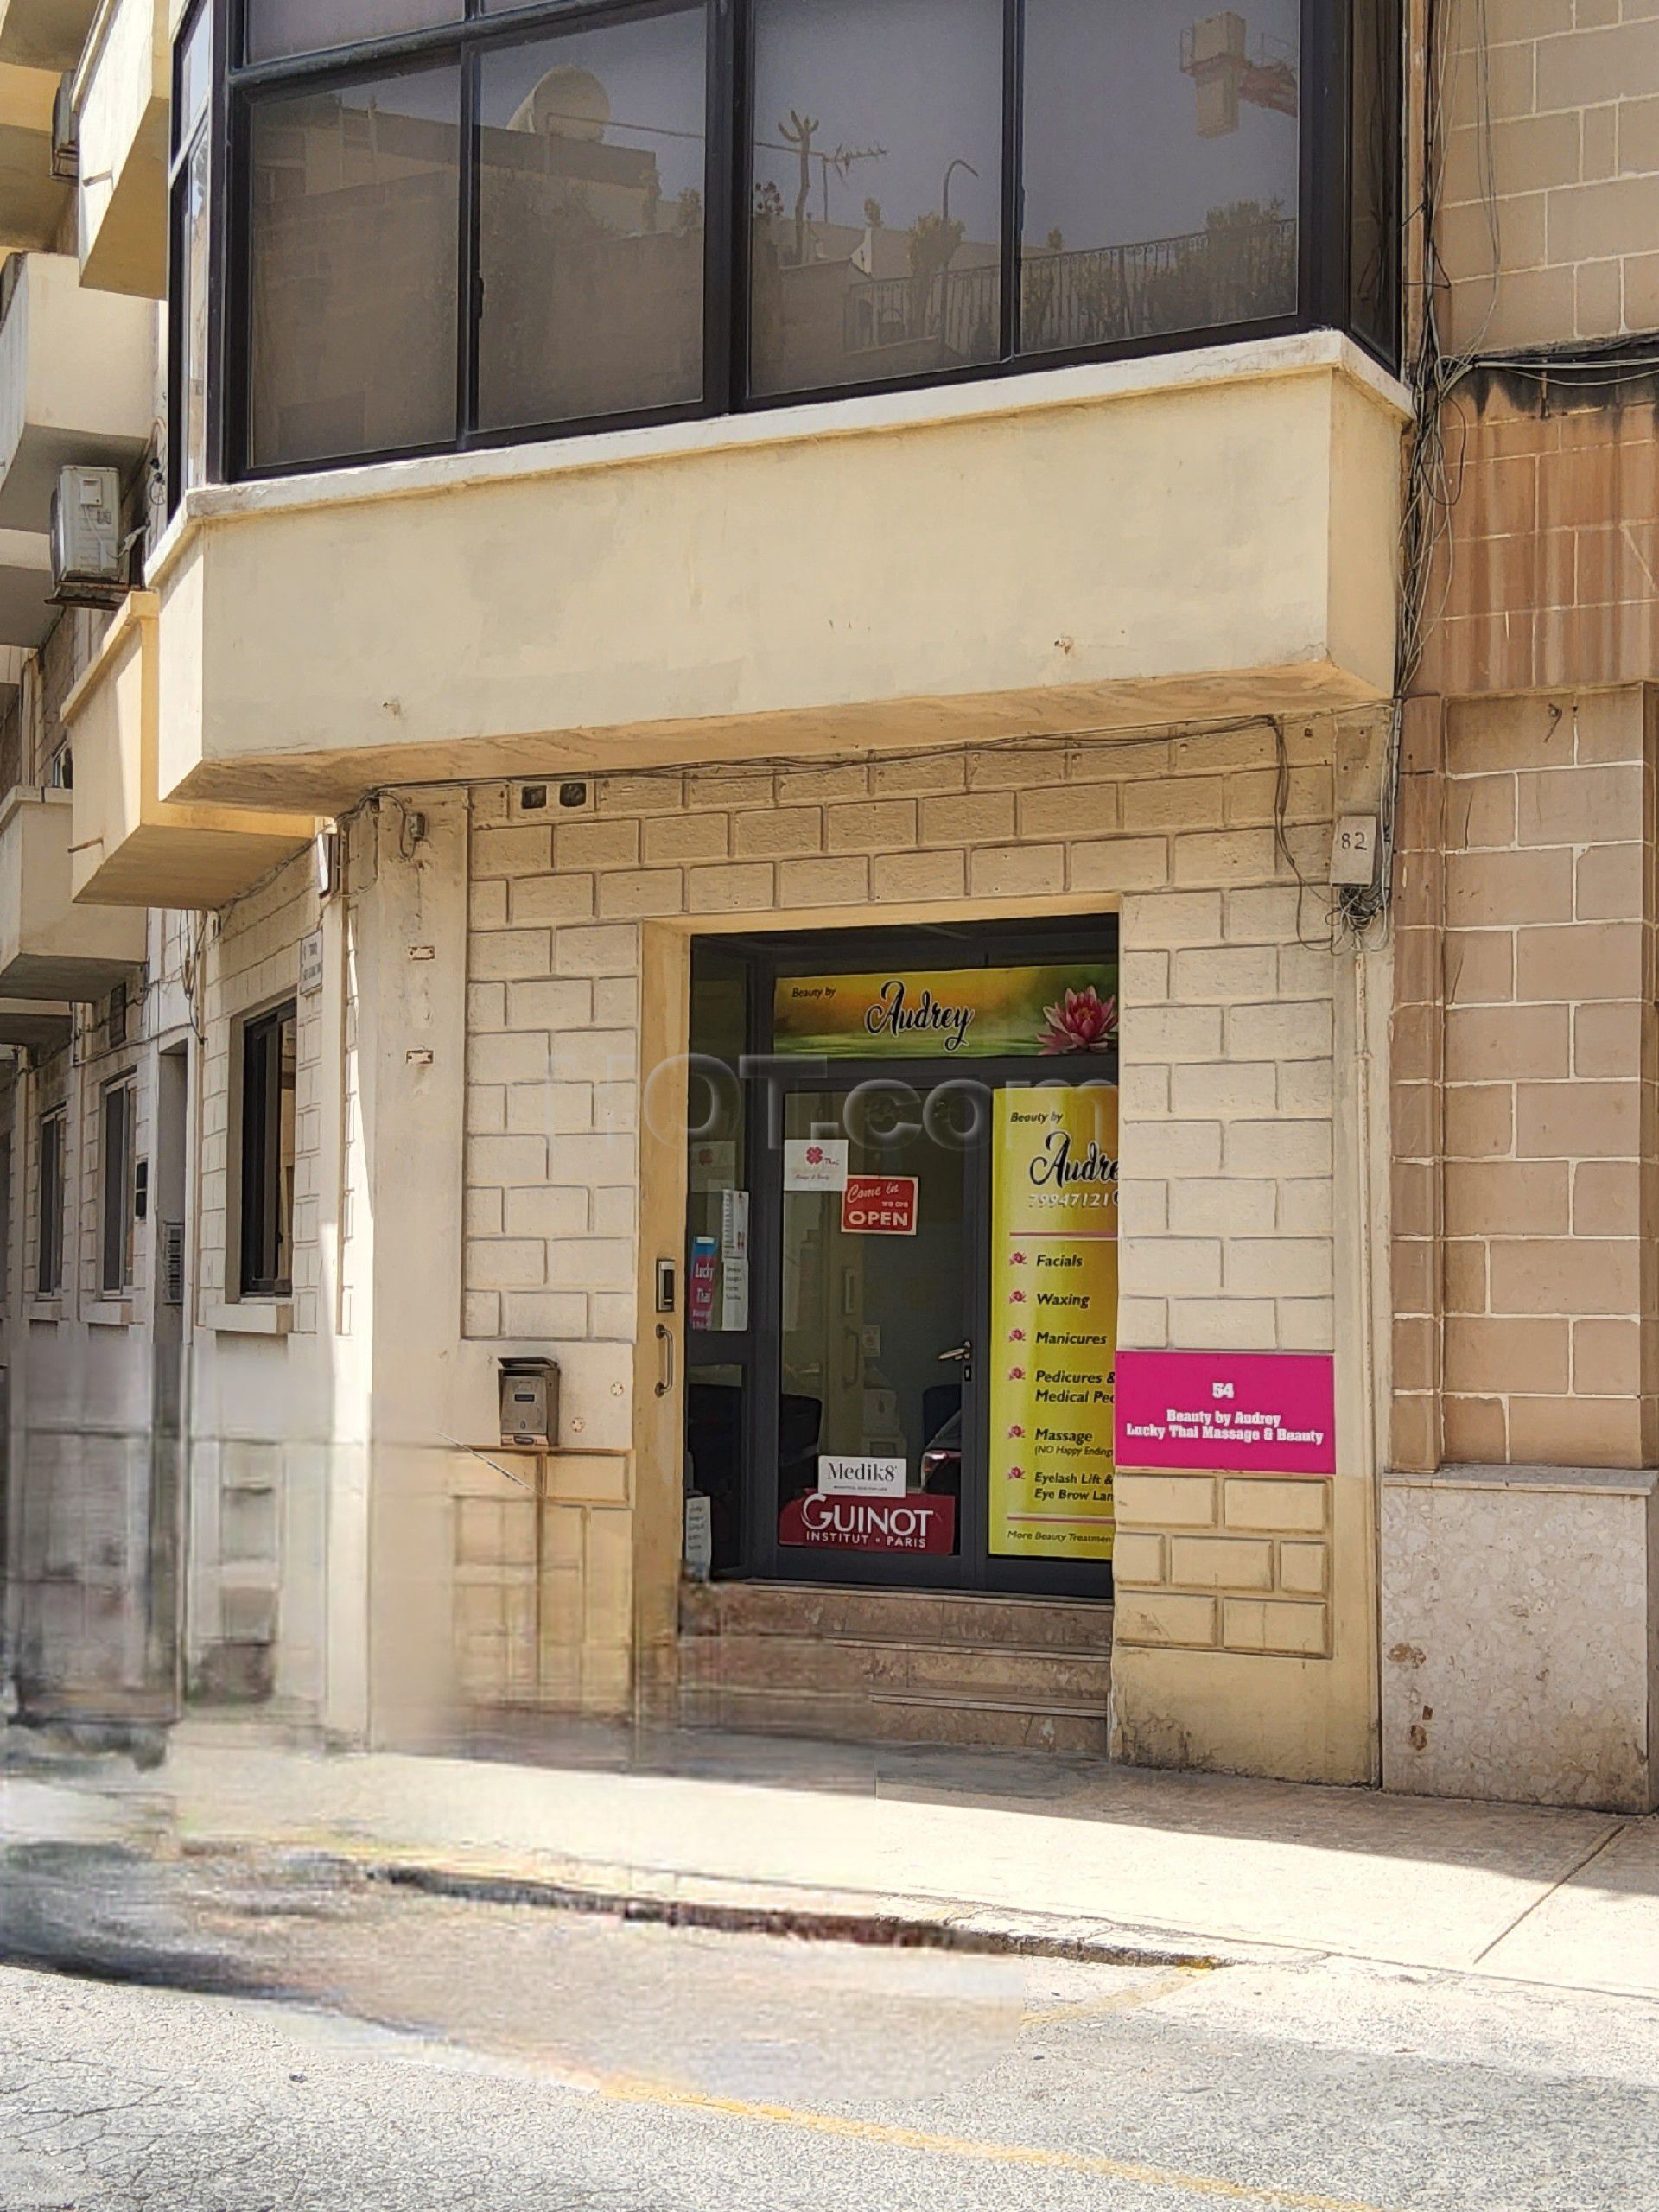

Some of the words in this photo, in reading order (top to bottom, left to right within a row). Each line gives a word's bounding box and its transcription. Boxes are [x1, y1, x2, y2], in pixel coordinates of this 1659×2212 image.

[1341, 832, 1367, 850] 82
[791, 987, 822, 999] Beauty
[824, 987, 836, 997] by
[866, 980, 974, 1052] Audrey
[1010, 1112, 1048, 1124] Beauty
[1051, 1111, 1064, 1123] by
[847, 1184, 881, 1203] Come
[886, 1183, 899, 1195] in
[848, 1211, 908, 1226] OPEN
[1037, 1255, 1083, 1267] Facials
[1037, 1294, 1090, 1309] Waxing
[1036, 1332, 1107, 1344] Manicures
[1036, 1370, 1103, 1383] Pedicures
[1107, 1371, 1115, 1383] &
[1035, 1389, 1089, 1403] Medical
[1212, 1382, 1235, 1398] 54
[1166, 1409, 1212, 1425] Beauty
[1215, 1410, 1231, 1426] by
[1235, 1411, 1281, 1427] Audrey
[1035, 1428, 1093, 1445] Massage
[1127, 1423, 1166, 1440] Lucky
[1169, 1425, 1198, 1439] Thai
[1202, 1426, 1260, 1443] Massage
[1263, 1428, 1273, 1440] &
[1277, 1428, 1324, 1445] Beauty
[1035, 1445, 1054, 1456] (NO
[1056, 1446, 1082, 1457] Happy
[828, 1462, 895, 1482] Medik8
[1035, 1472, 1077, 1484] Eyelash
[1081, 1473, 1100, 1484] Lift
[1035, 1488, 1054, 1501] Eye
[1058, 1489, 1089, 1500] Brow
[801, 1493, 933, 1537] GUINOT
[806, 1530, 869, 1545] INSTITUT
[887, 1536, 926, 1548] PARIS
[1007, 1530, 1033, 1540] More
[1035, 1531, 1065, 1542] Beauty
